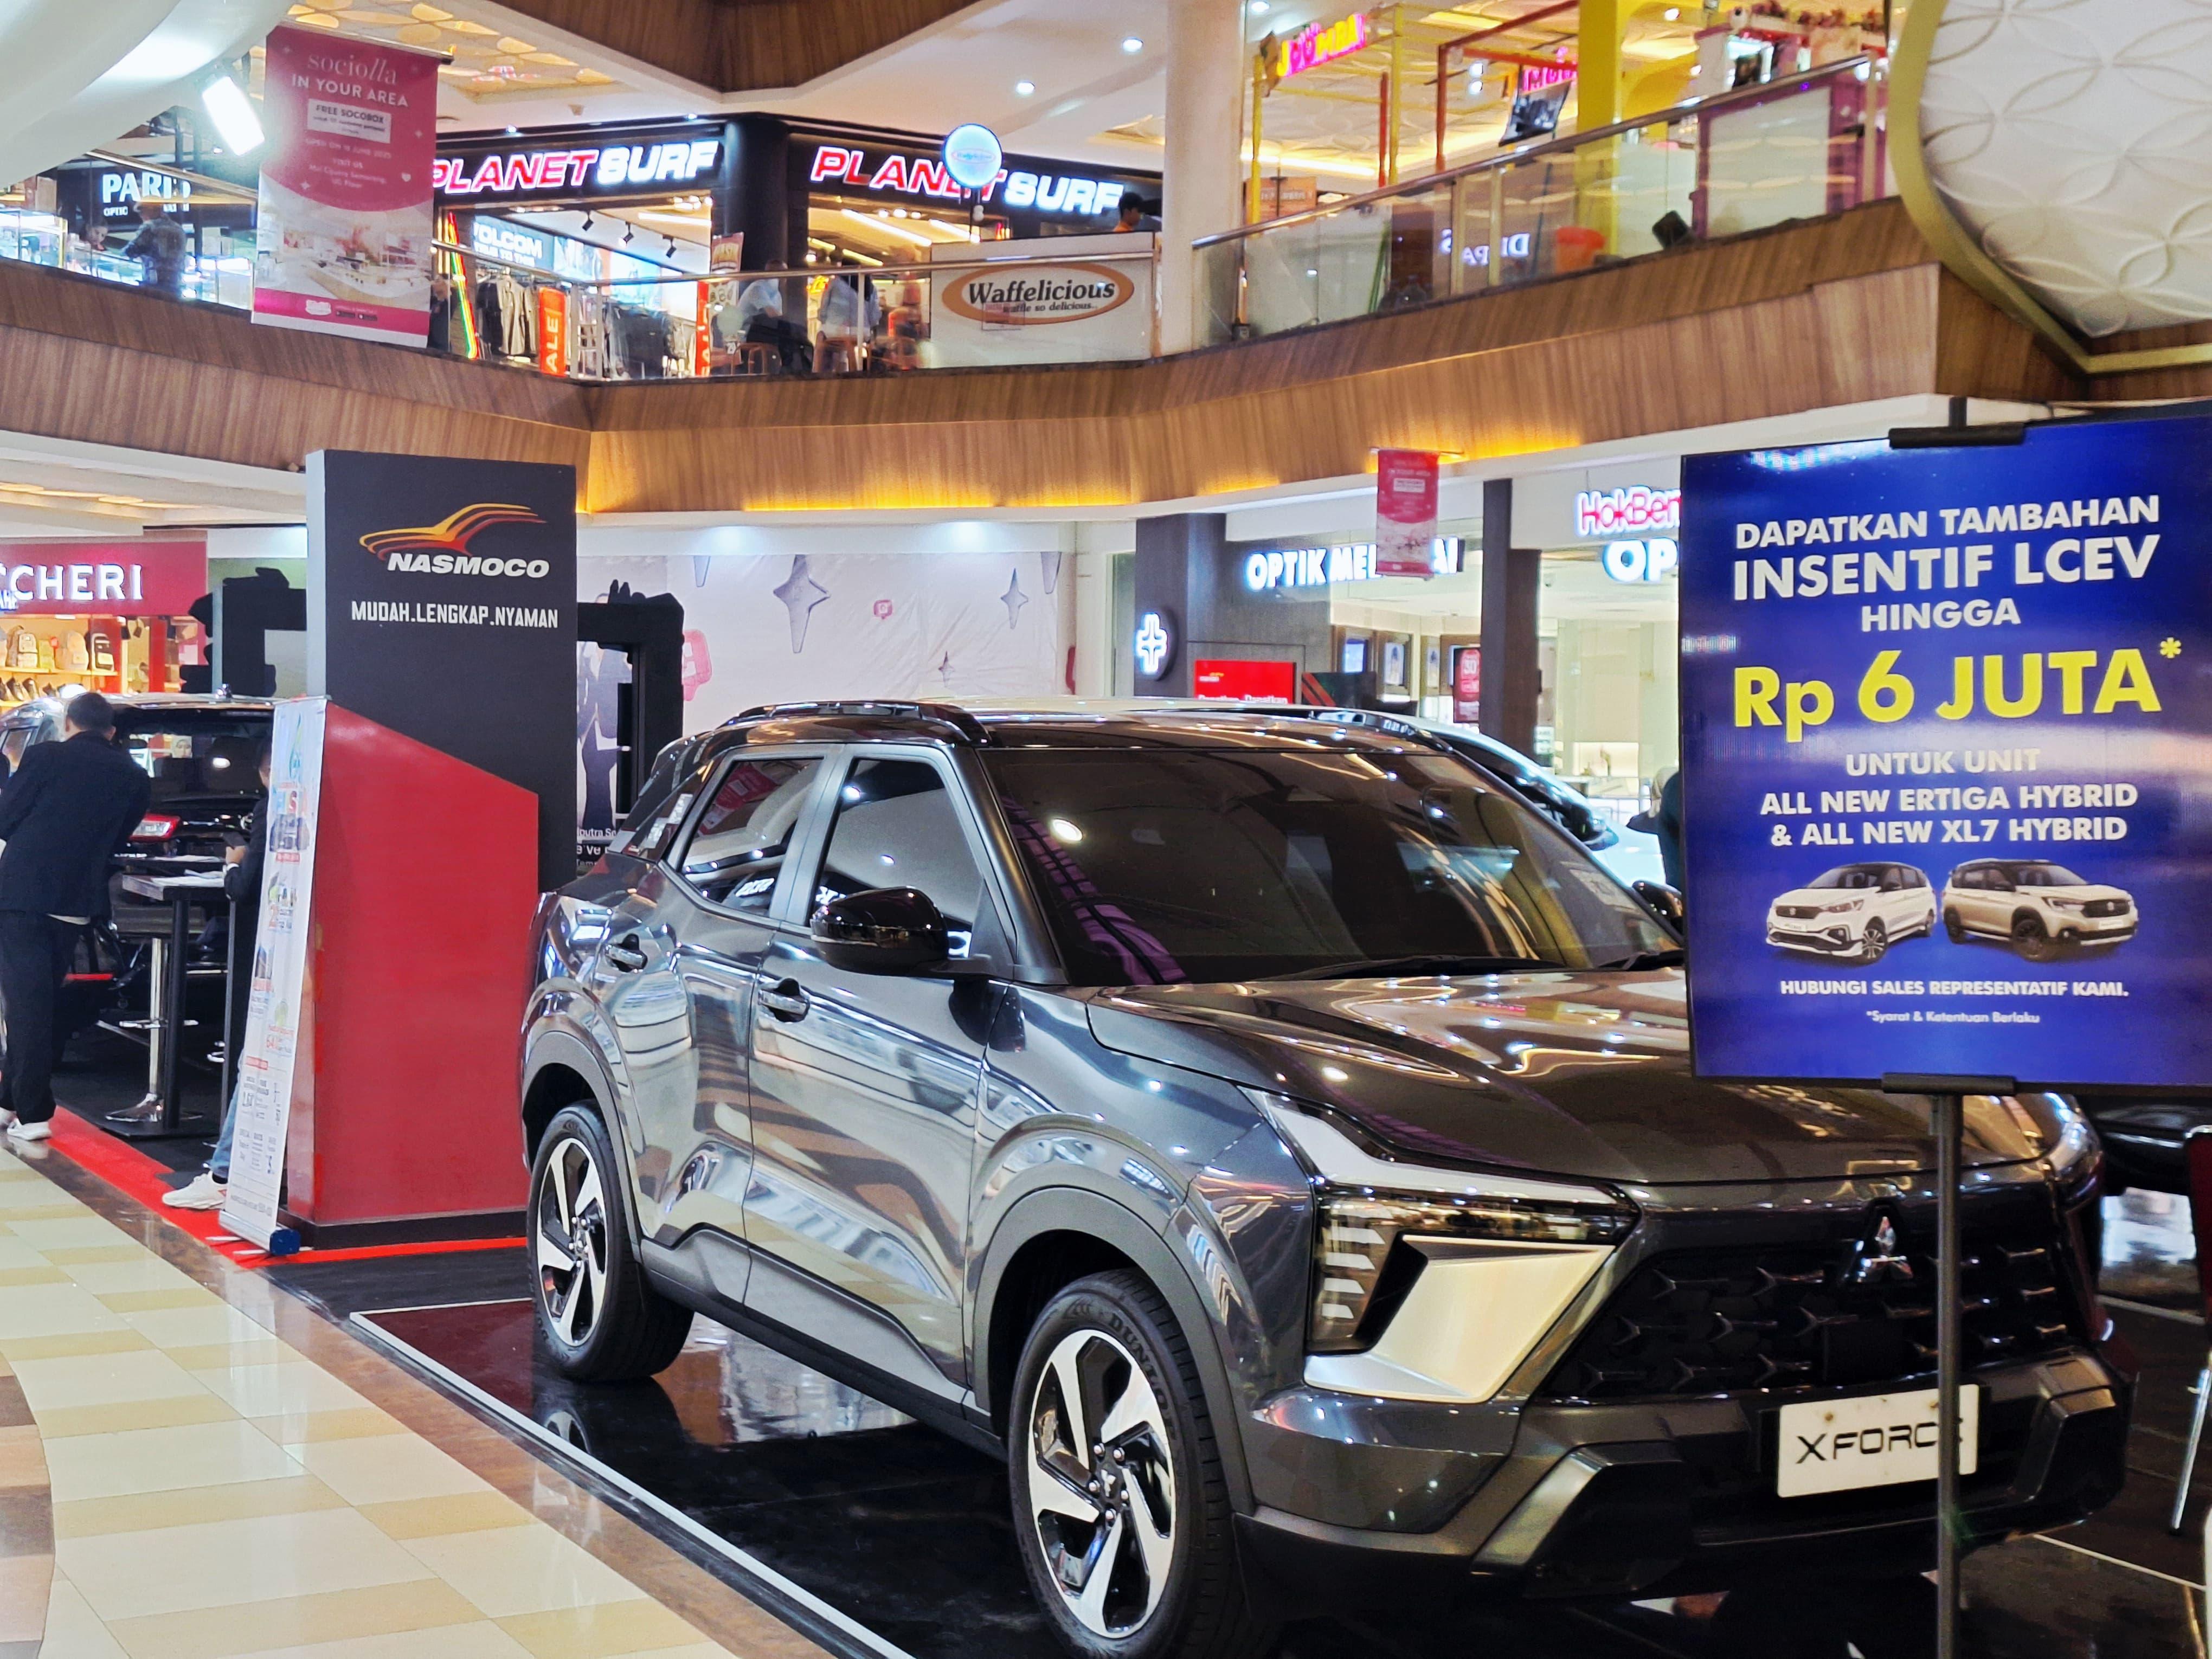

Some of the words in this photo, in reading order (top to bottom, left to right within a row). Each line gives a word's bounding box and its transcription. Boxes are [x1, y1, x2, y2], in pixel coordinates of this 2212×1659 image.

[307, 55, 397, 85] sociolla
[292, 74, 309, 88] IN
[317, 79, 362, 98] YOUR
[367, 89, 408, 107] AREA
[432, 149, 601, 194] PLANET
[595, 140, 720, 184] SURF
[1004, 171, 1124, 215] SURF
[968, 279, 1115, 304] Waffelicious
[1735, 511, 1928, 550] DAPATKAN
[1939, 494, 2159, 535] TAMBAHAN
[387, 552, 550, 578] NASMOCO
[1247, 548, 1328, 591] OPTIK
[1734, 546, 1993, 600] INSENTIF
[2015, 534, 2160, 585] LCEV
[351, 600, 558, 628] MUDAH.LENGKAP.NYAMAN
[1861, 598, 2021, 632] HINGGA
[1734, 666, 1835, 743] Rp
[1857, 650, 1915, 723] 6
[1846, 751, 1954, 776] UNTUK
[1964, 749, 2040, 772] UNIT
[1760, 792, 1811, 815] ALL
[1821, 789, 1889, 813] NEW
[1899, 787, 2010, 812] ERTIGA
[2019, 783, 2138, 808] HYBRID
[1770, 826, 1792, 846] &
[1803, 823, 1855, 845] ALL
[1863, 821, 1931, 844] NEW
[1940, 819, 1997, 843] XL7
[2008, 816, 2127, 840] HYBRID
[1780, 980, 1867, 995] HUBUNGI
[1872, 980, 1925, 995] SALES
[1929, 981, 2068, 996] REPRESENTATIF
[2072, 981, 2129, 997] KAMI.
[1992, 1012, 2040, 1024] Berlaku
